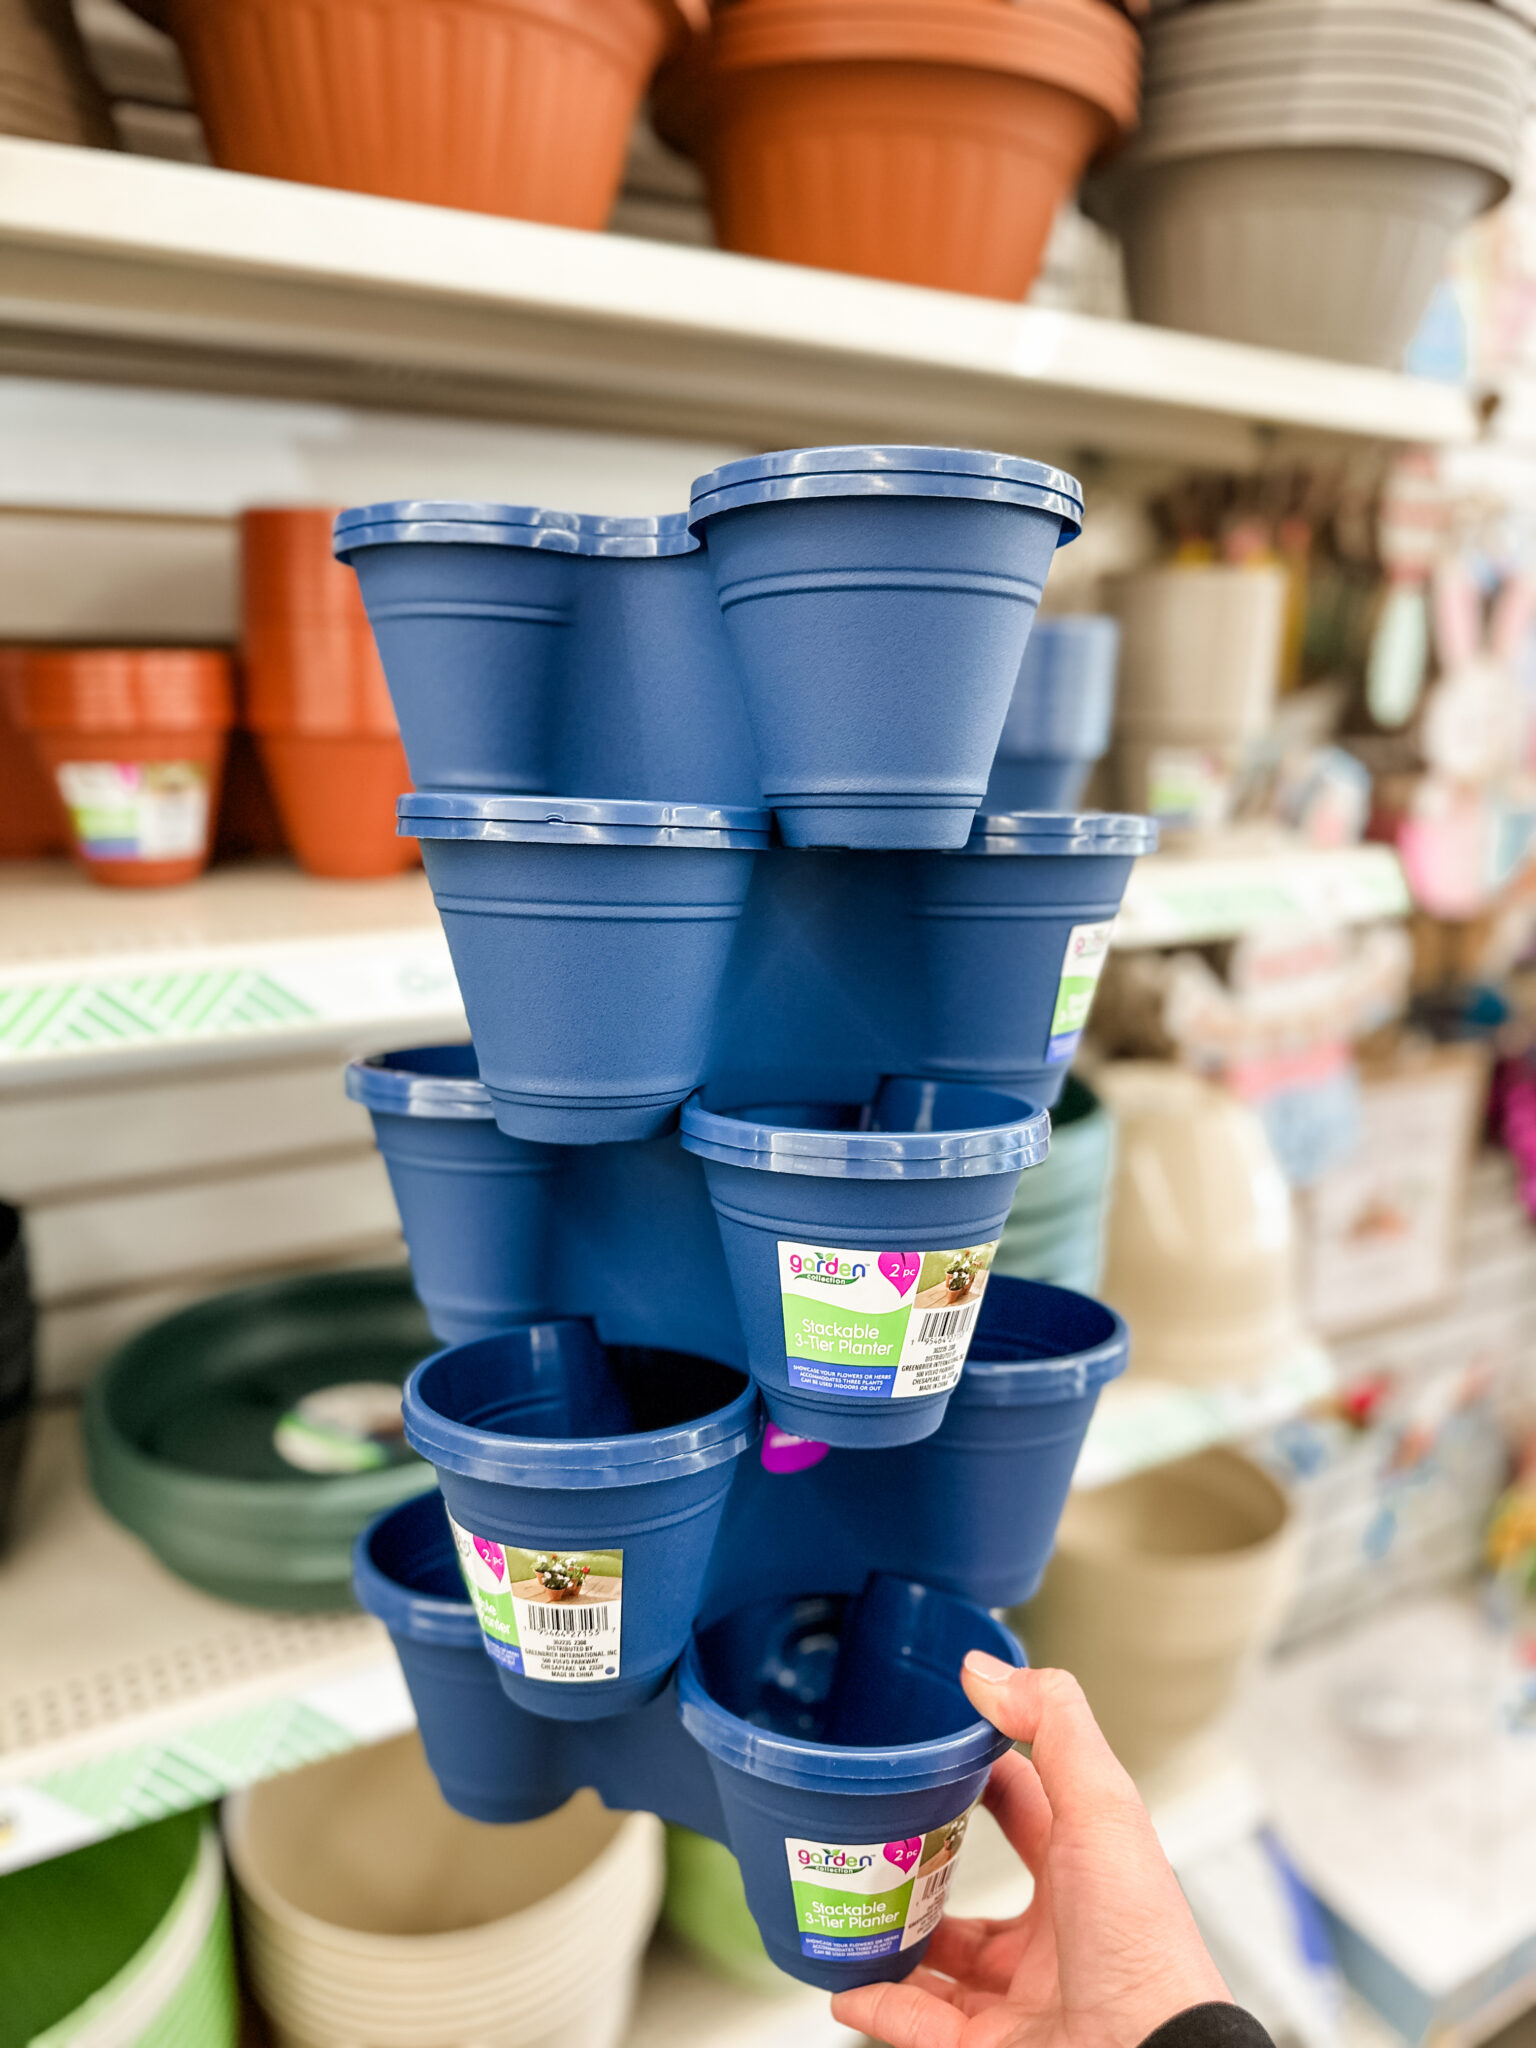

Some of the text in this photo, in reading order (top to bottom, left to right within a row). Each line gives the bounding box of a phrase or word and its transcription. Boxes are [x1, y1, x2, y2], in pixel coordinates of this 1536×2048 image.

[790, 1254, 866, 1277] garden
[889, 1263, 916, 1278] 2 pc
[806, 1274, 846, 1285] collection
[802, 1319, 879, 1339] Stackable
[795, 1334, 893, 1356] 3-Tier Planter
[793, 1365, 819, 1374] SHOWCASE
[800, 1372, 841, 1383] ACCOMMODATES
[483, 1549, 503, 1565] 2 pc
[798, 1849, 872, 1867] garden
[894, 1849, 918, 1861] 2 pc
[815, 1866, 853, 1874] collection
[811, 1901, 886, 1916] Stackable
[805, 1911, 899, 1928] 3-Tier Planter
